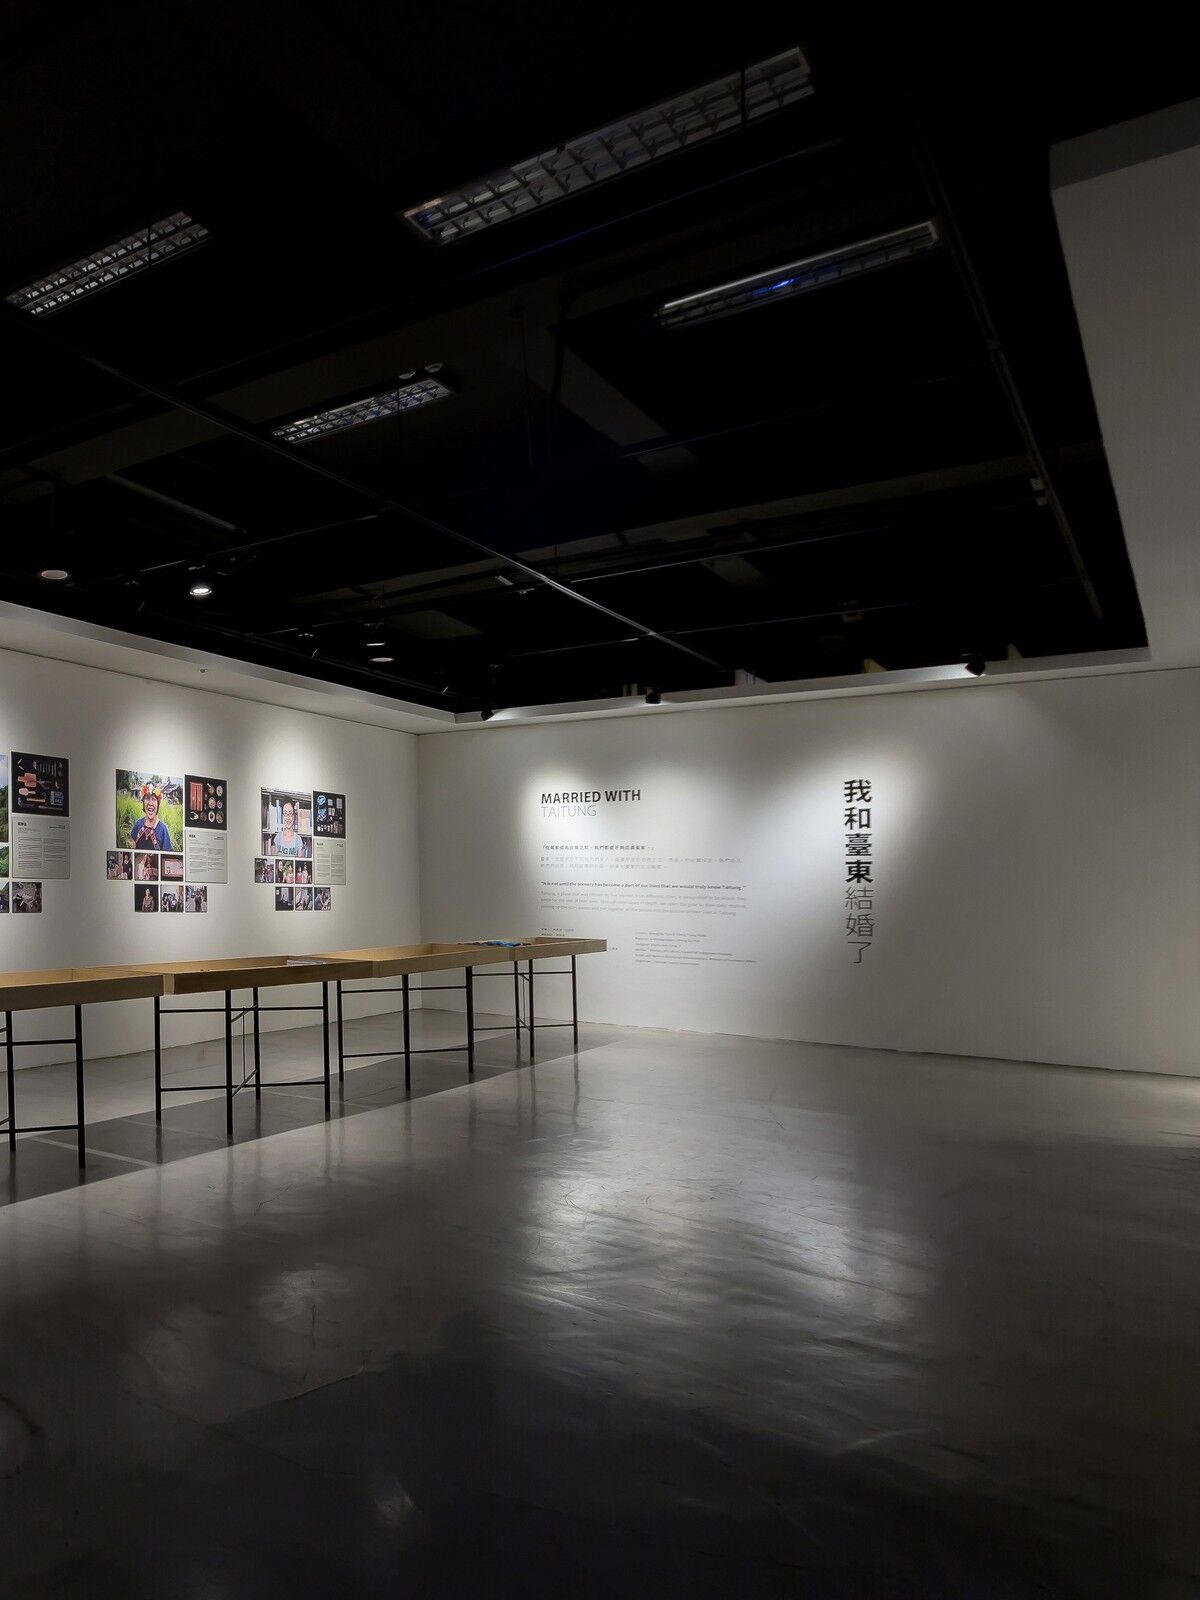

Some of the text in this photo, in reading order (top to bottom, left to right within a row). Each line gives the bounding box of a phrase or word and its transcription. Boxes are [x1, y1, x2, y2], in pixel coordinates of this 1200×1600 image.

[541, 789, 641, 804] MARRIED WITH
[540, 804, 597, 817] TAITUNG
[844, 779, 875, 964] 我和臺東結婚了
